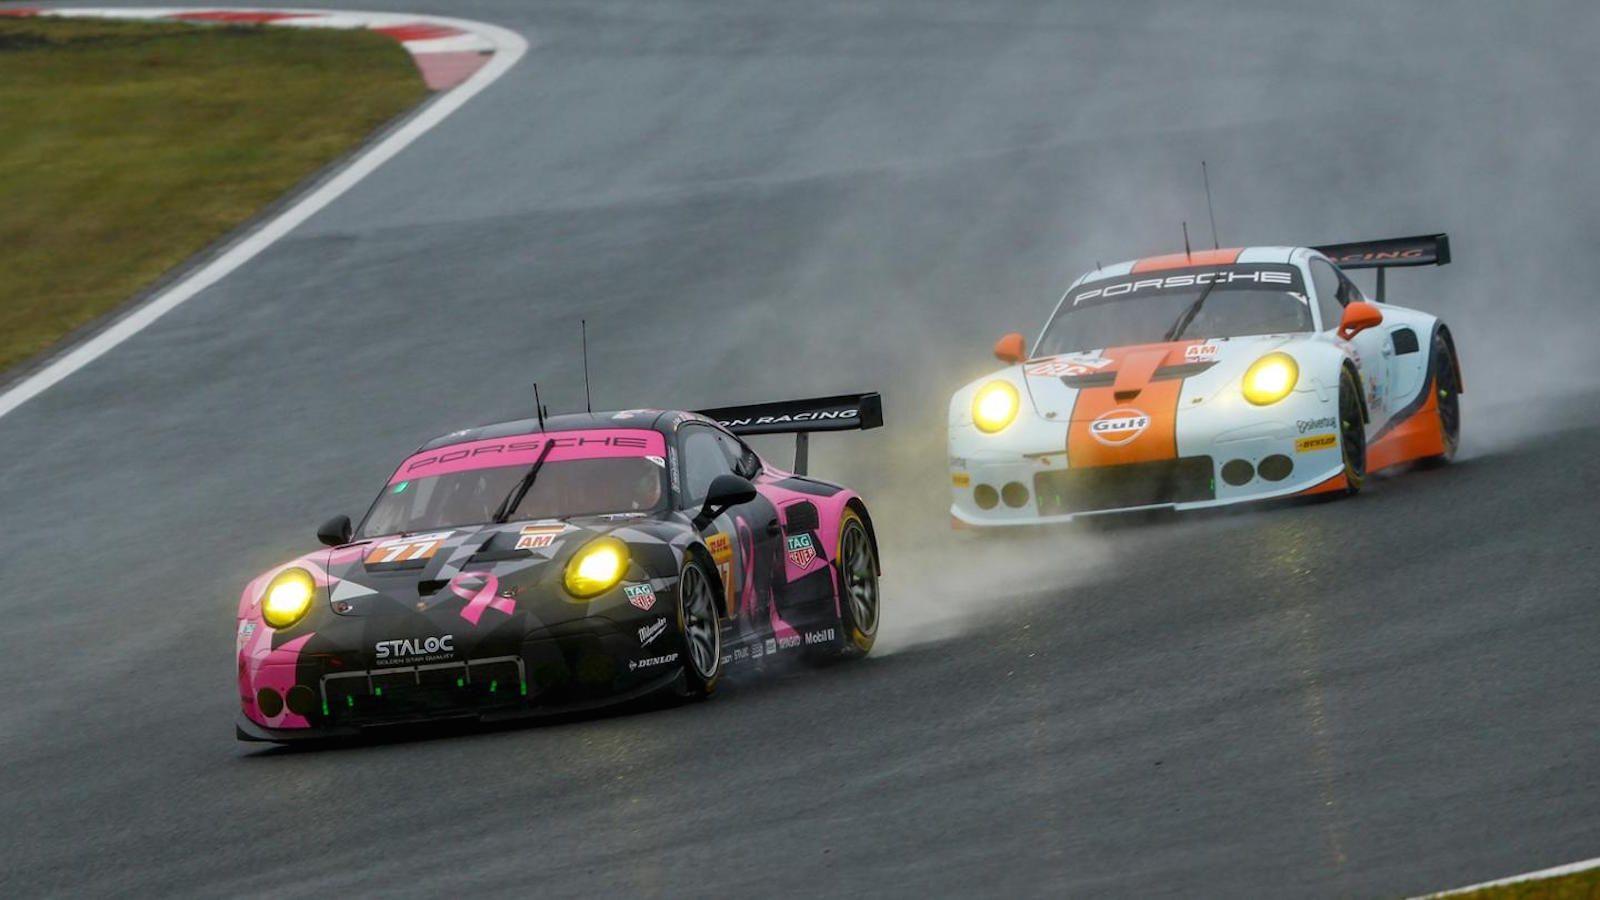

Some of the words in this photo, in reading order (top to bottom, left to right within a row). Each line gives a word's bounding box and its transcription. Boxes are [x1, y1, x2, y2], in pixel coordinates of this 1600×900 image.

[1073, 270, 1292, 306] PORSCHE
[1187, 345, 1217, 355] AM
[755, 409, 859, 424] RACING
[1092, 416, 1148, 431] Gulf
[407, 436, 648, 473] PORSCHE
[519, 534, 552, 548] AM
[788, 536, 810, 550] TAG
[379, 541, 434, 563] 77
[789, 548, 815, 567] HEUER
[628, 585, 651, 597] TAG
[804, 630, 827, 645] Mobil
[375, 634, 454, 659] STALOC
[638, 652, 679, 668] DUNLOP
